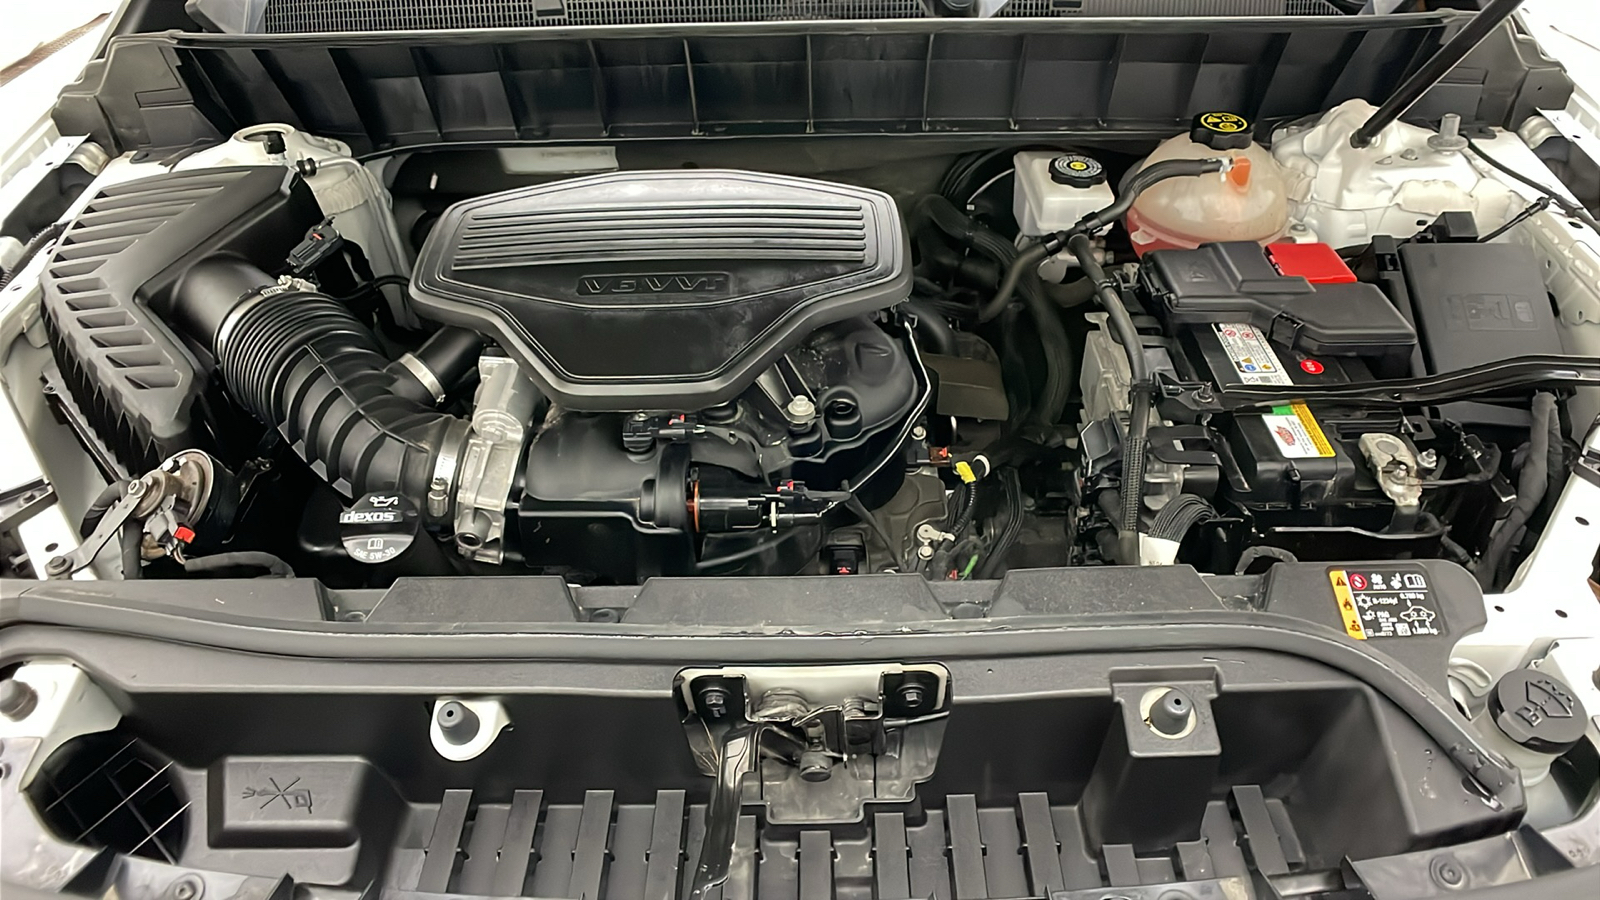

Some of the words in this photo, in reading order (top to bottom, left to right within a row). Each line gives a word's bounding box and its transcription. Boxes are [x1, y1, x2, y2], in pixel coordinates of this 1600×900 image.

[343, 510, 396, 522] dexos
[353, 547, 368, 560] SAE
[369, 546, 396, 560] 5W-30
